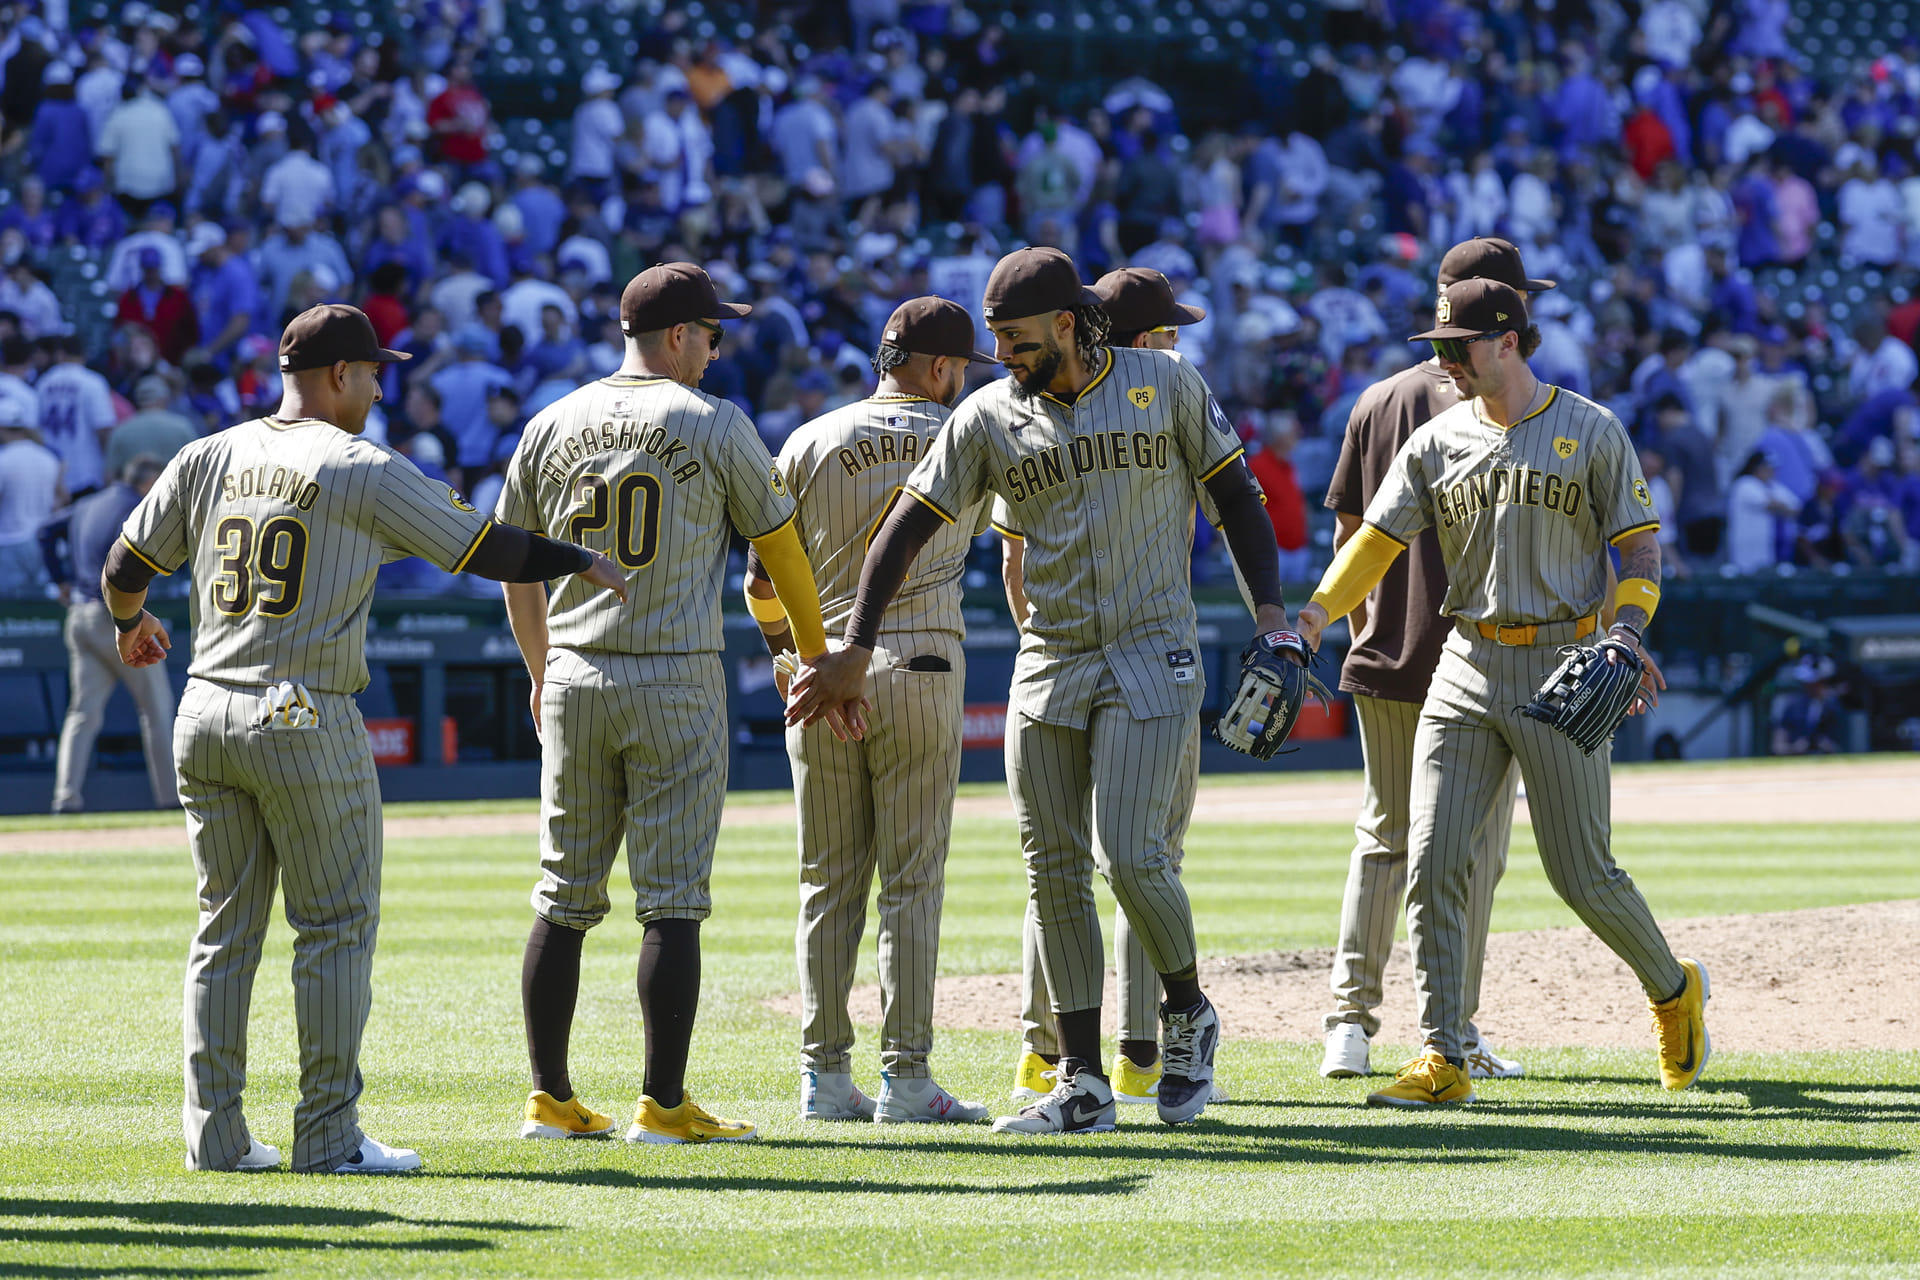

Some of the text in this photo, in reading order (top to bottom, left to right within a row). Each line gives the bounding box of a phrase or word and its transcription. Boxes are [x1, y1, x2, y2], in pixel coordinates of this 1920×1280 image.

[1135, 391, 1149, 404] PS
[541, 420, 702, 488] HIGASHIOKA
[1005, 431, 1169, 504] SAN DIEGO
[1559, 442, 1573, 454] PS
[222, 465, 321, 512] SOLANO
[1437, 468, 1583, 529] SAN DIEGO
[569, 472, 663, 570] 20
[213, 515, 310, 618] 39
[1265, 699, 1288, 742] Rawlings
[1569, 687, 1592, 714] A2000
